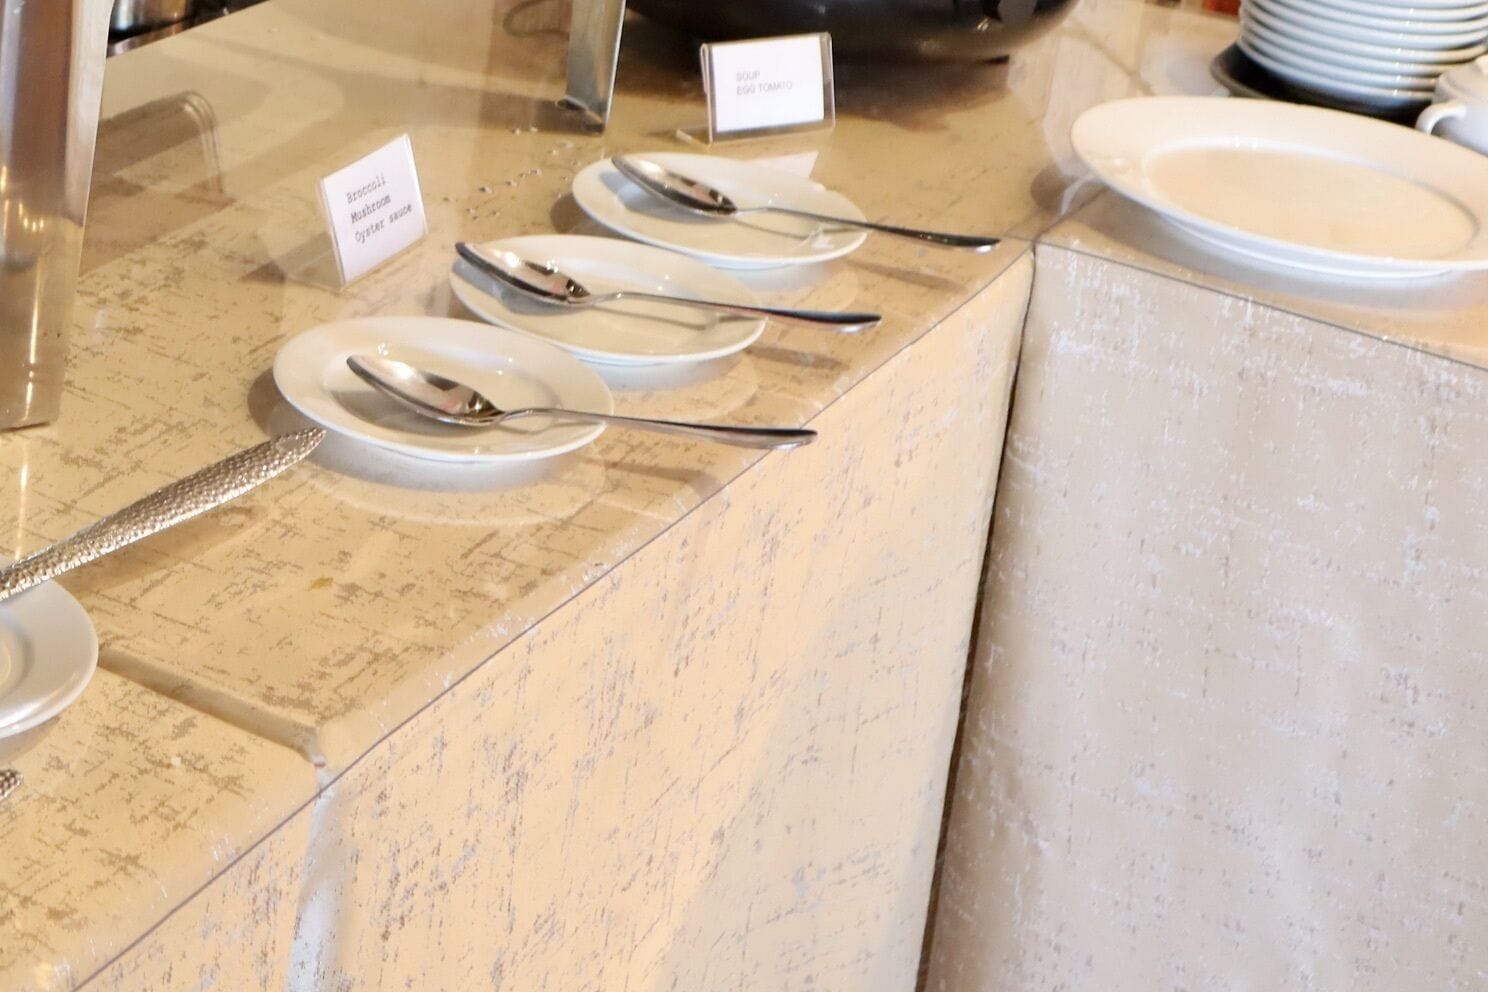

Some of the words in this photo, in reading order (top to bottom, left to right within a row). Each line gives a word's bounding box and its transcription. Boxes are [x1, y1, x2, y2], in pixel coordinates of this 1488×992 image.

[736, 70, 761, 82] SOUP
[736, 84, 756, 96] EGG
[759, 81, 792, 92] TOMATO
[346, 173, 386, 204] Broccoli
[350, 194, 391, 224] Mushroom
[355, 217, 385, 244] Oyster
[389, 203, 412, 223] sauce
